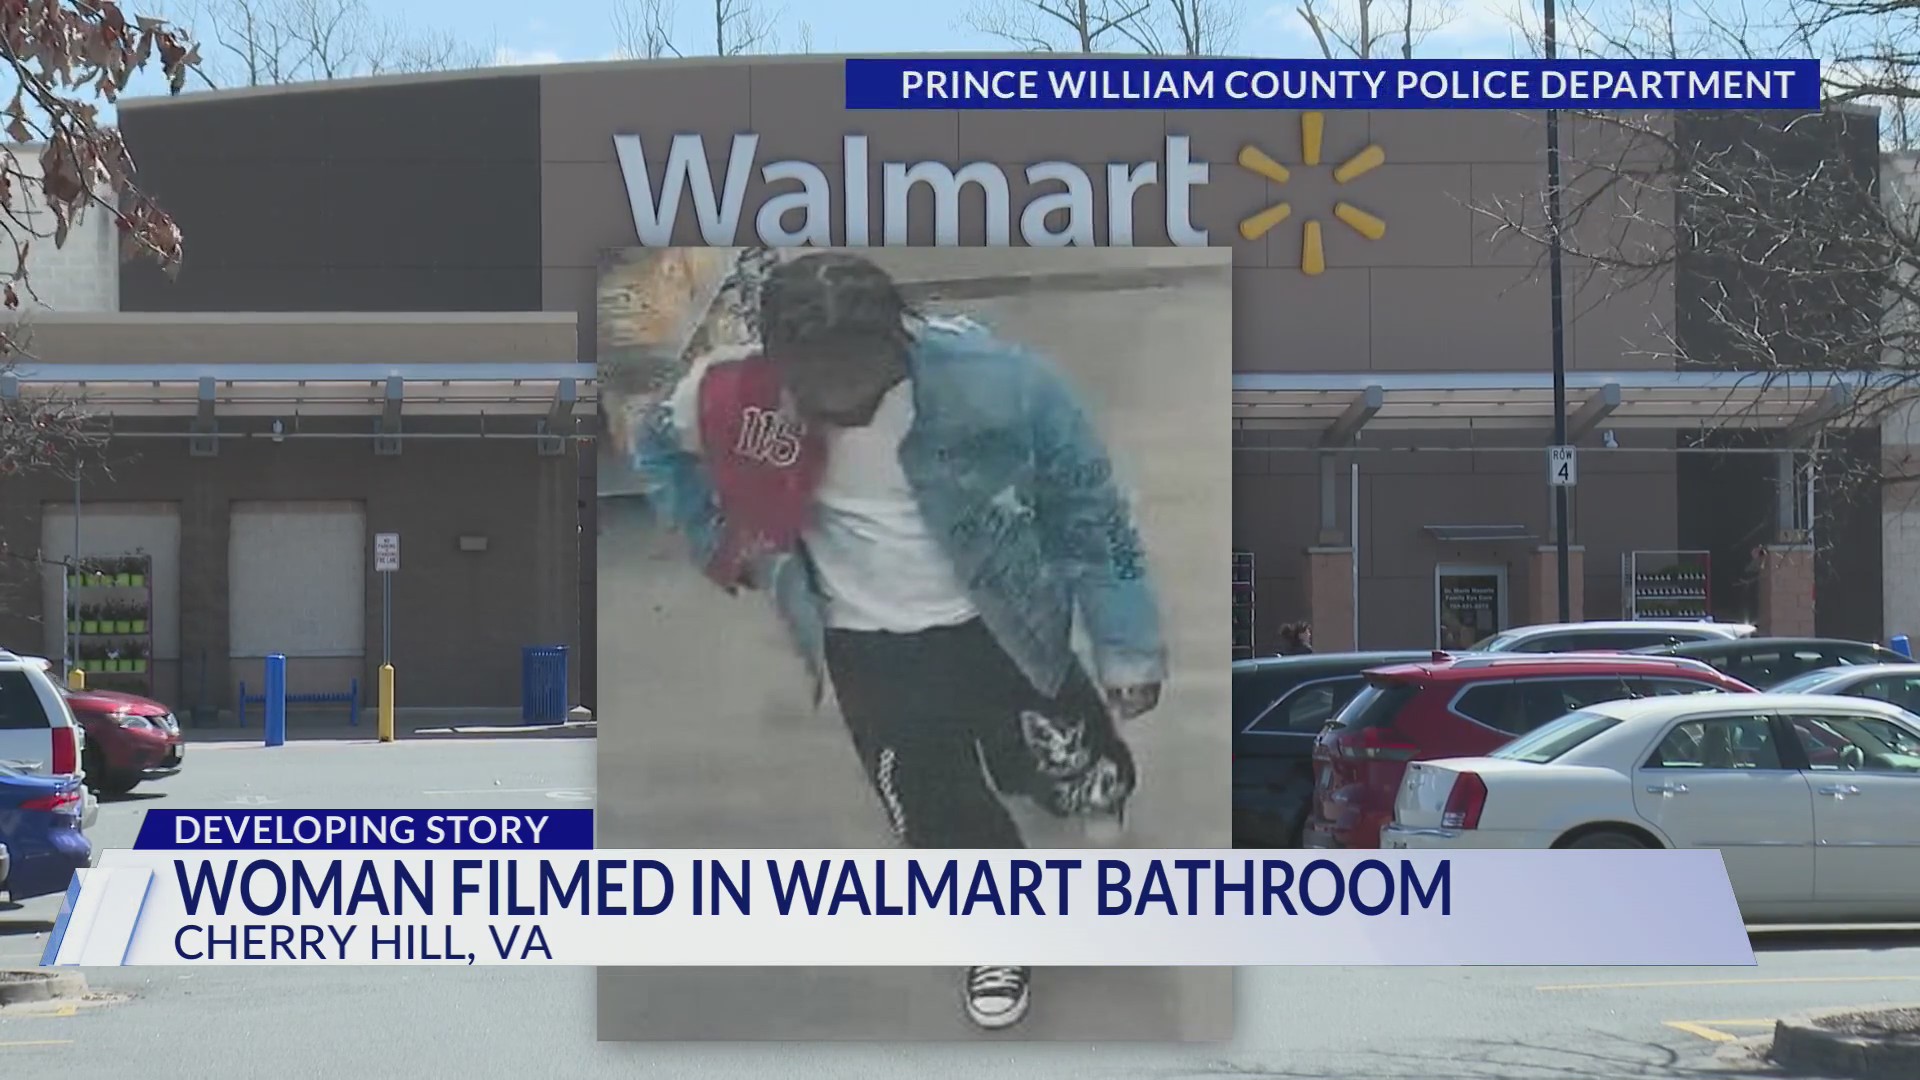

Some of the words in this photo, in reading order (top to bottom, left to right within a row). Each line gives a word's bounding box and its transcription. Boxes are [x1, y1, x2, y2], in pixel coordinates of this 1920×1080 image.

[612, 132, 1210, 247] Walmart
[1553, 449, 1573, 461] ROW
[1558, 462, 1569, 481] 4
